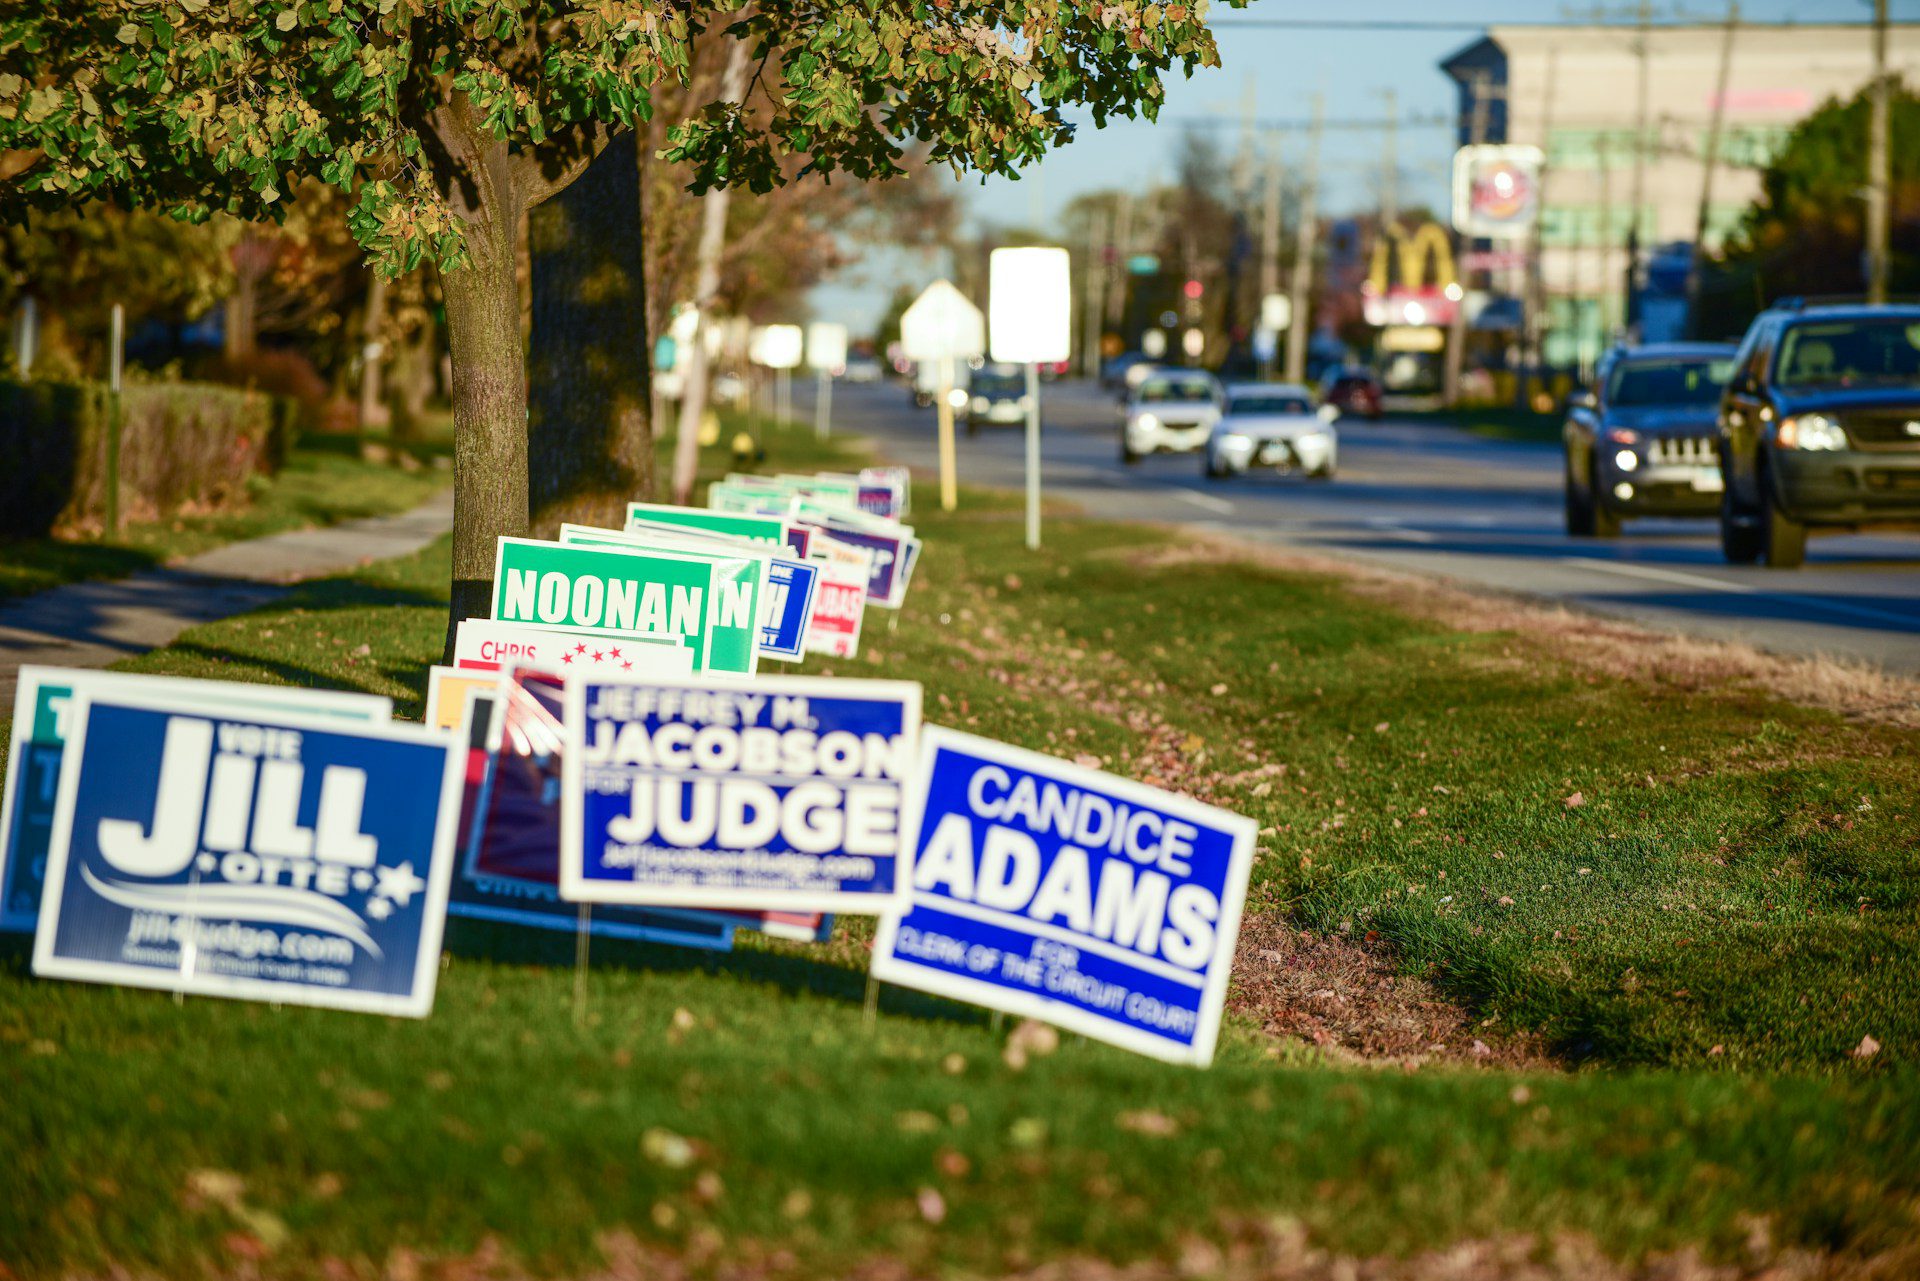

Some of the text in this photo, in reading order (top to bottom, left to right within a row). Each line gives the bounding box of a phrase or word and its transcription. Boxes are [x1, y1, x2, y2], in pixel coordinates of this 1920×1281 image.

[504, 568, 703, 636] NOONAN
[481, 641, 536, 662] CHRIS
[587, 686, 818, 730] JEFFREY M.
[218, 724, 302, 759] VOTE
[585, 720, 903, 779] JACOBSON
[98, 716, 378, 877] JILL
[607, 772, 898, 855] JUDGE
[968, 766, 1198, 877] CANDICE
[221, 852, 349, 896] OTTE
[913, 812, 1219, 970] ADAMS
[897, 925, 1198, 1036] CLERK OF THE CIRCUIT COURT
[1030, 937, 1080, 971] FOR
